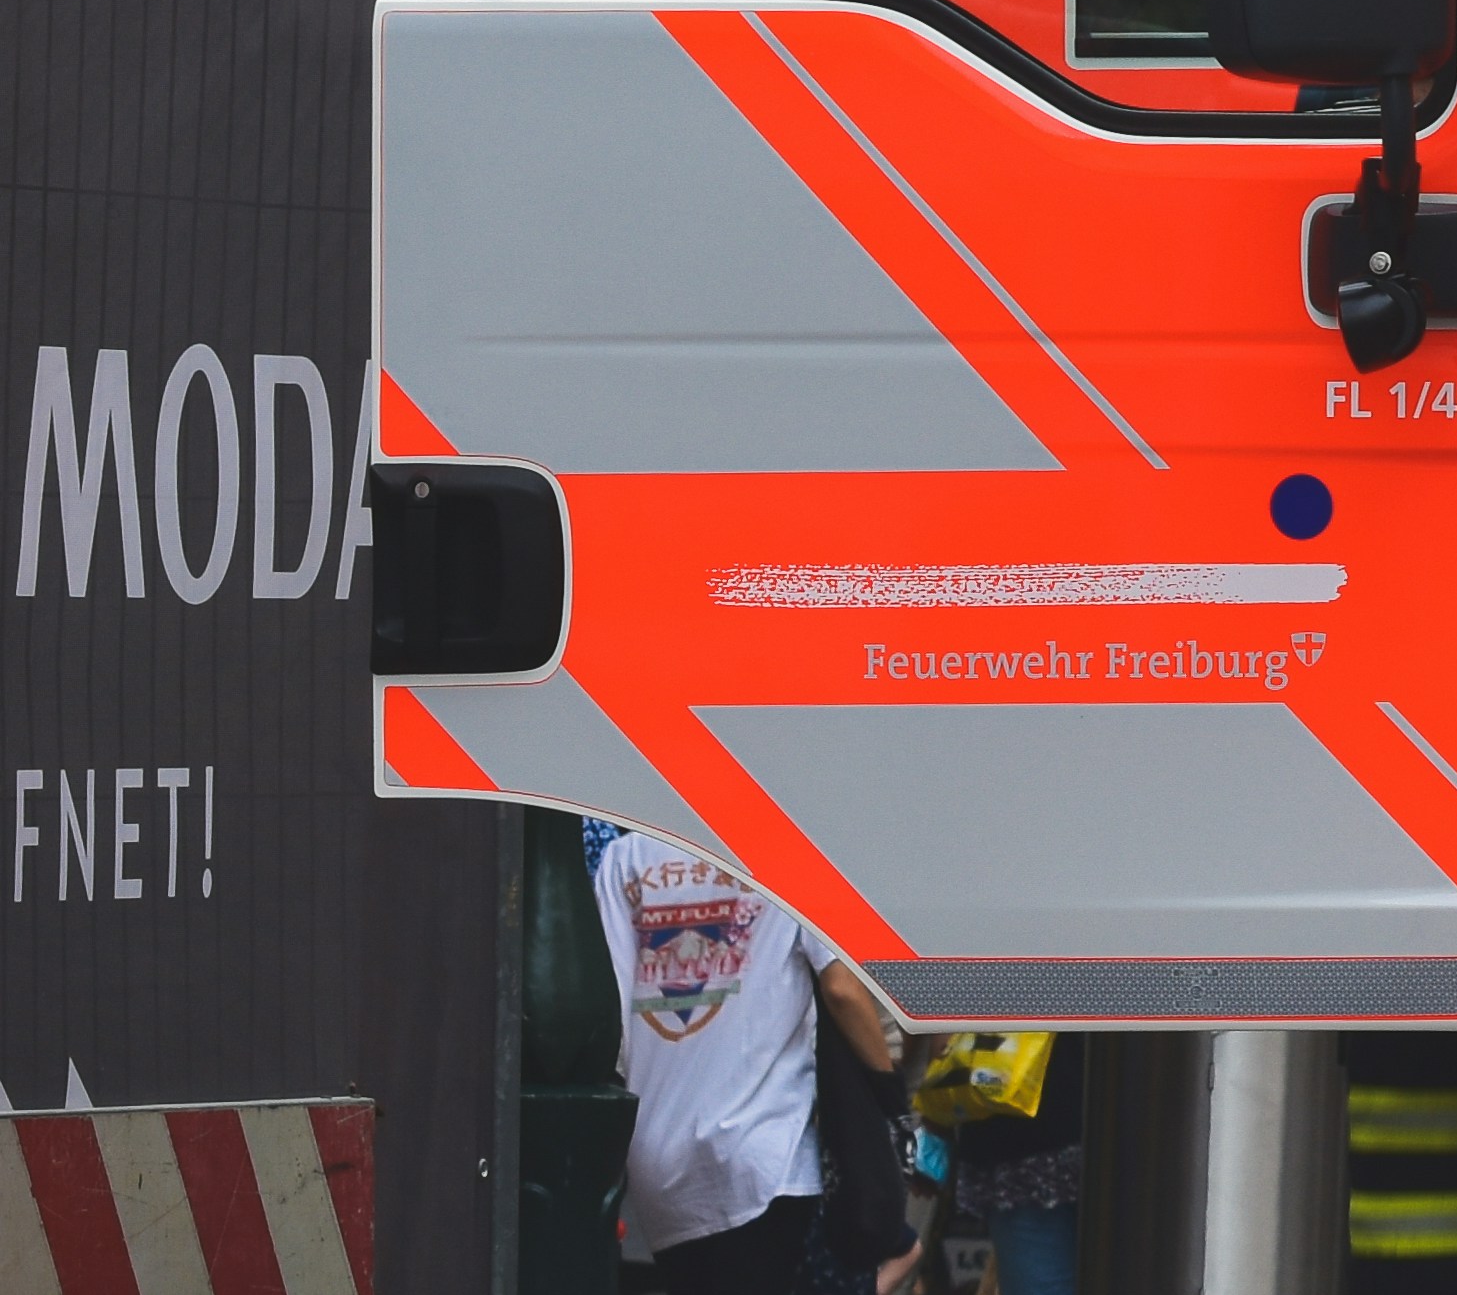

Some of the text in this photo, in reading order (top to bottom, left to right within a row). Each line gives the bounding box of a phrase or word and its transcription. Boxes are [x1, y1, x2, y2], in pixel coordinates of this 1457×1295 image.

[1325, 381, 1371, 419] FL
[863, 641, 1288, 690] Feuerwehr Freiburg
[14, 765, 214, 903] FNET!
